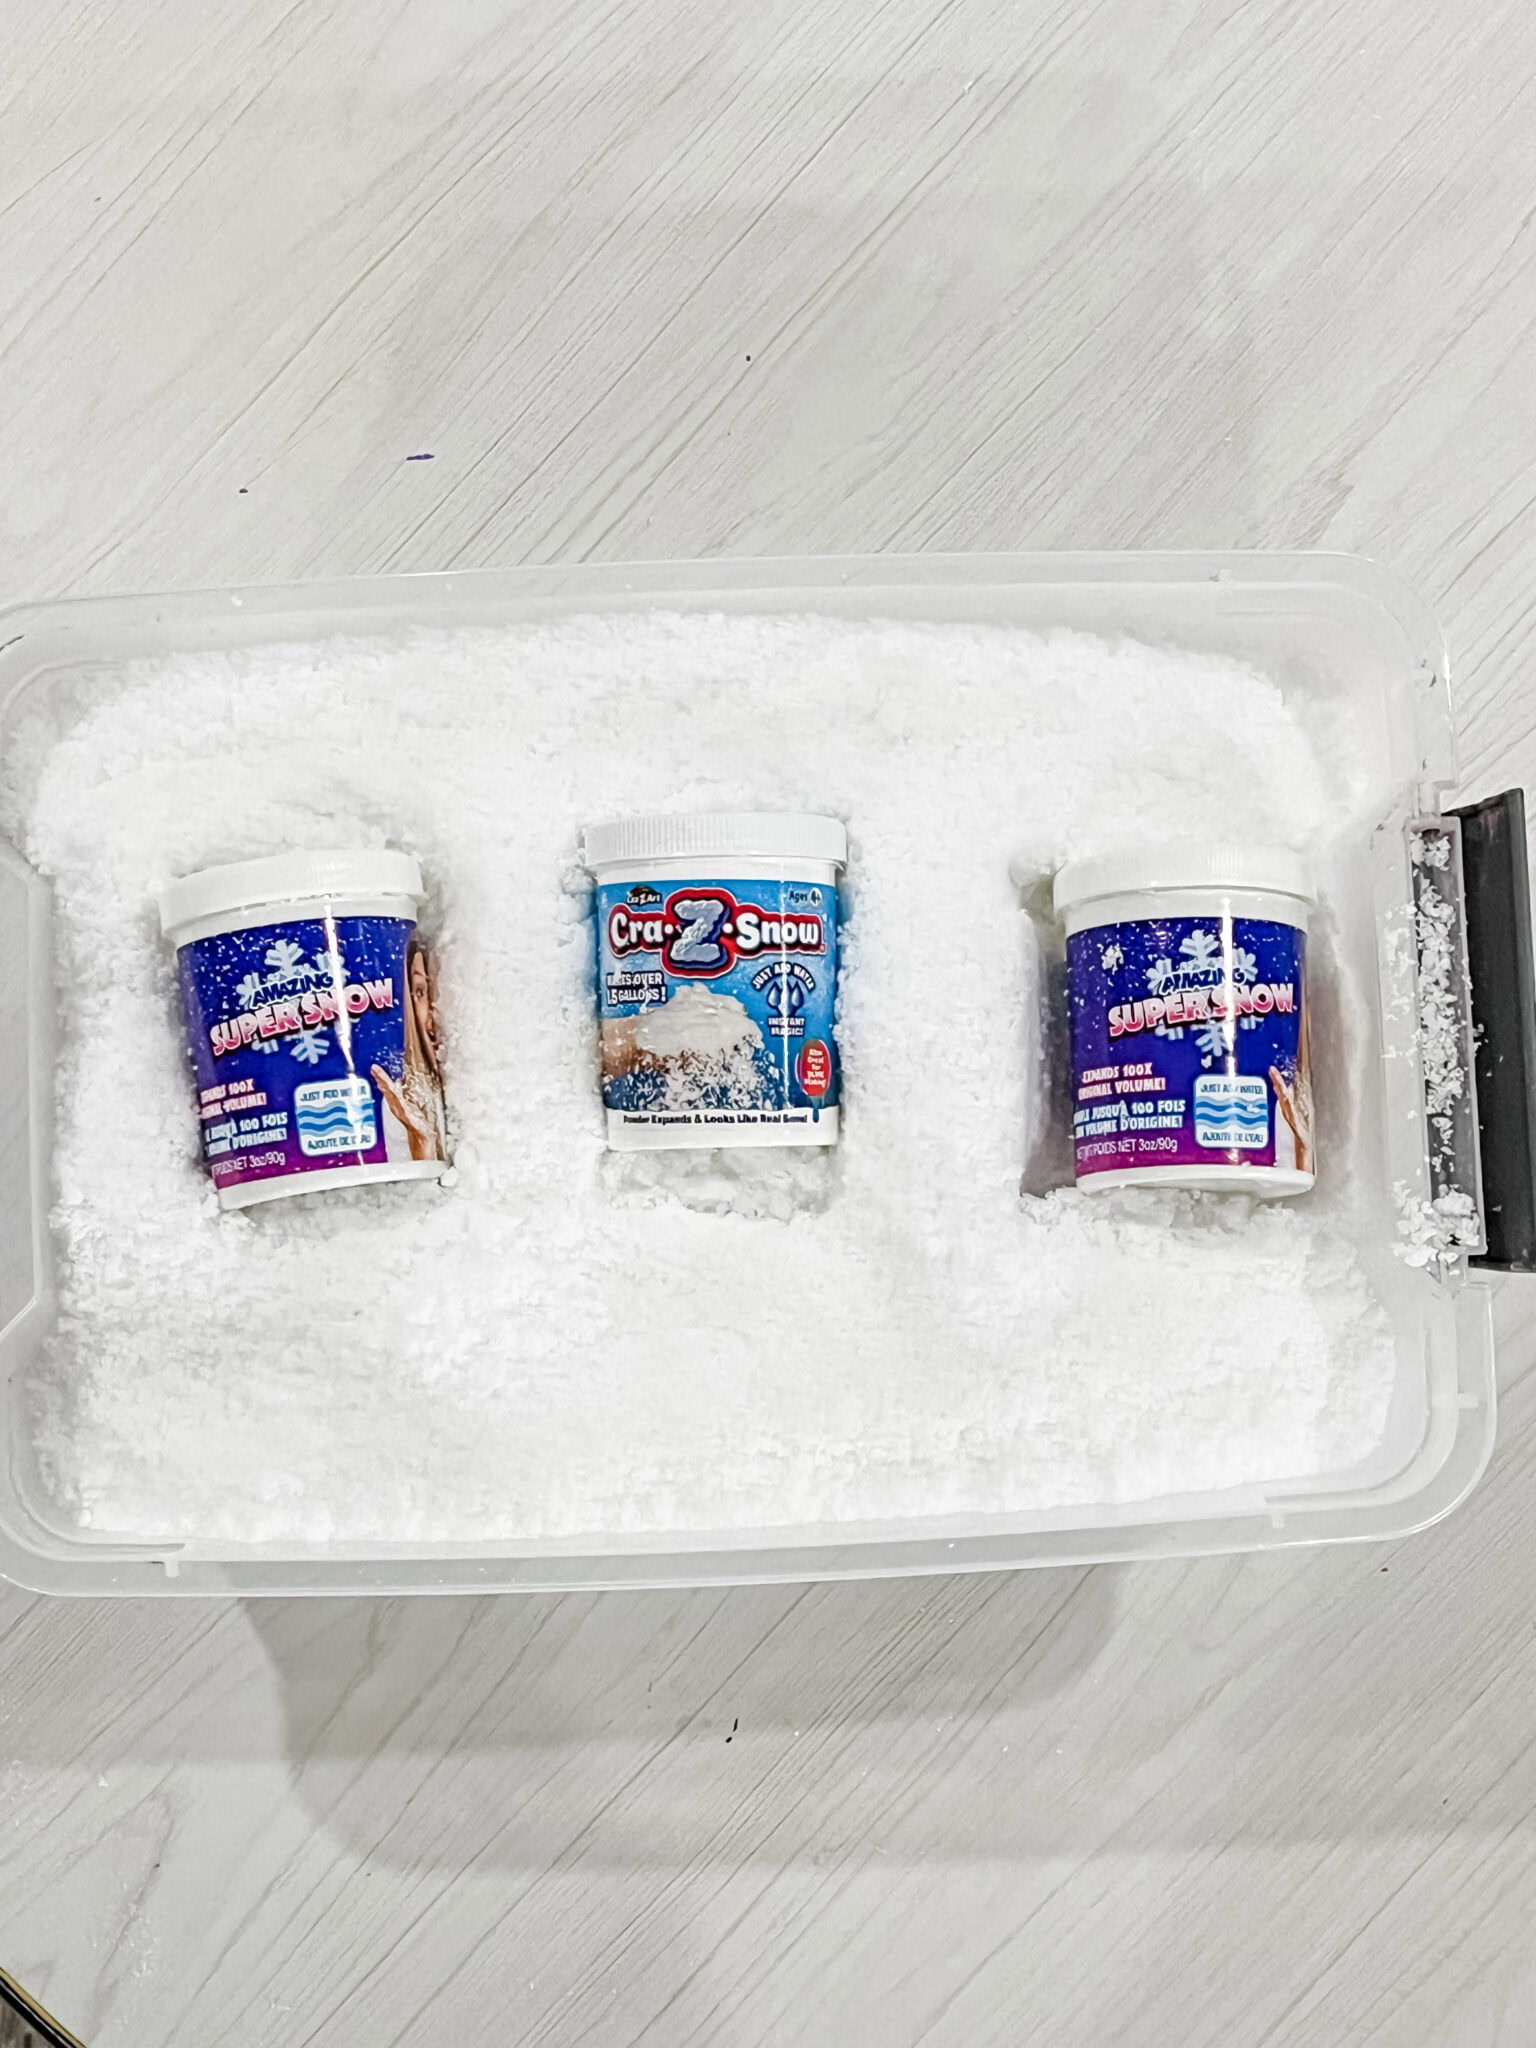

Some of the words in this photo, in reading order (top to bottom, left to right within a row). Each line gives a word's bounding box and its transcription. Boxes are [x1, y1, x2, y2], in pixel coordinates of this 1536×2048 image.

[633, 973, 663, 986] OVER
[752, 967, 773, 990] JUST
[774, 963, 792, 975] AD
[251, 971, 334, 1008] AMAZING
[1122, 1062, 1153, 1077] 100X
[1115, 1077, 1166, 1095] VOLUME!
[1131, 1102, 1155, 1115] 100
[1157, 1099, 1187, 1114] FOIS
[239, 1117, 260, 1132] 100
[261, 1111, 288, 1129] FOIS
[651, 1114, 692, 1126] Expands
[704, 1114, 735, 1124] Looks
